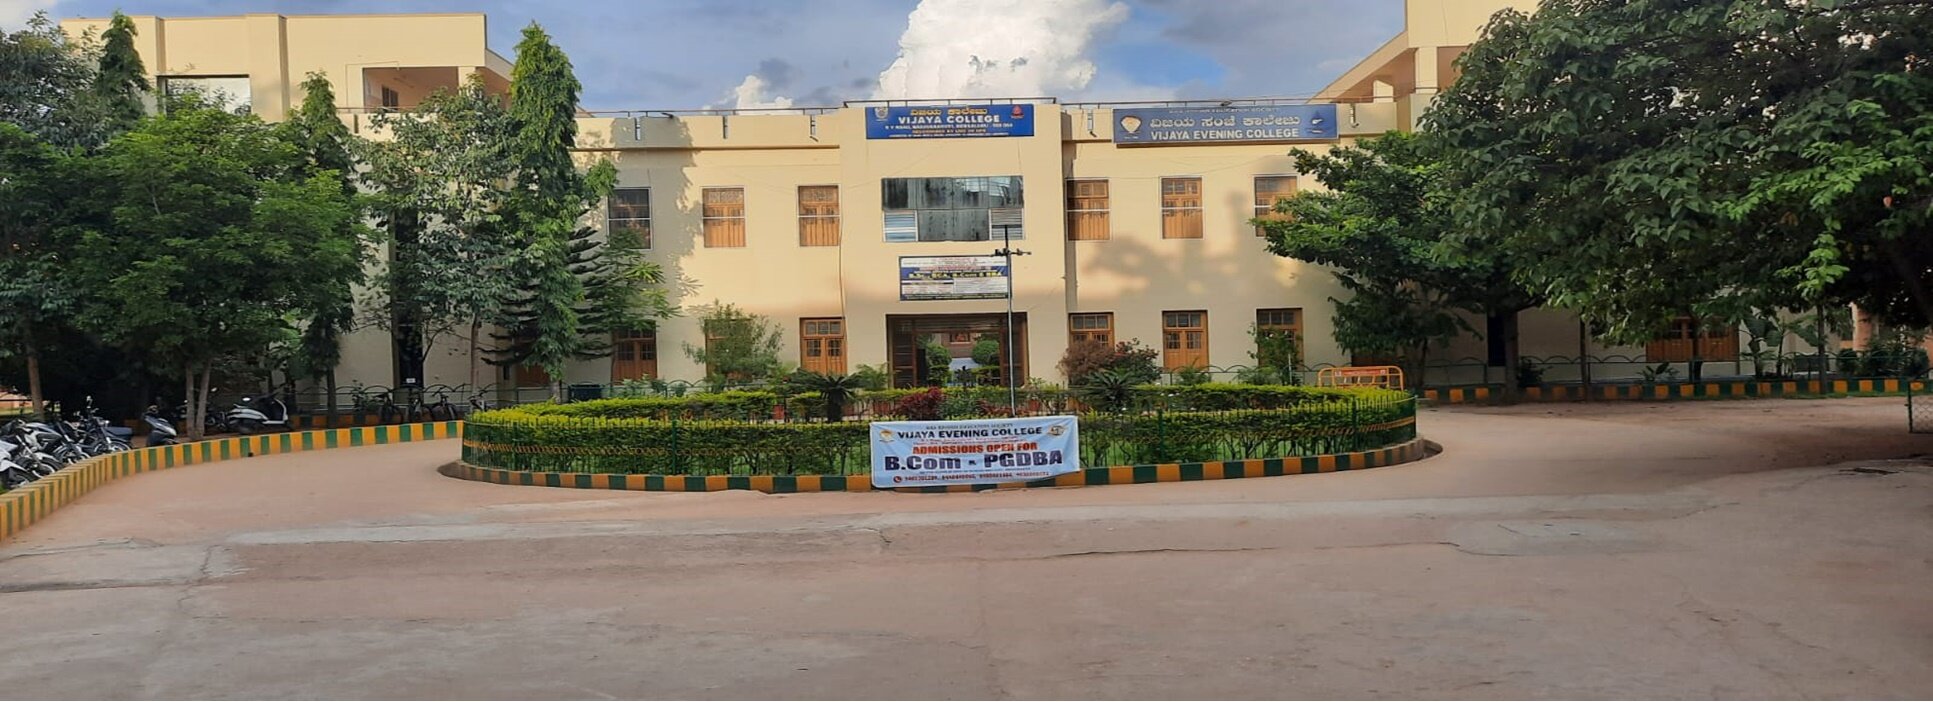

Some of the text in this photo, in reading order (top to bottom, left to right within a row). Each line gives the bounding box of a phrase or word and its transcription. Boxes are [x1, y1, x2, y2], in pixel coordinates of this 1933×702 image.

[898, 115, 1000, 124] VIJAYA COLLEGE
[1149, 114, 1300, 128] ವಿಜಯ ಸಂಜೆ ಕಾಲೇಜು
[1150, 128, 1299, 140] VIJAYA EVENING COLLEGE
[897, 430, 935, 439] VIJAYA
[938, 429, 988, 438] EVENING
[991, 427, 1043, 436] COLLEGE
[912, 444, 984, 454] ADMISSIONS
[986, 443, 1014, 452] OPEN
[1017, 442, 1038, 451] FOR
[885, 456, 961, 470] B.Com
[983, 450, 1063, 468] PGDBA
